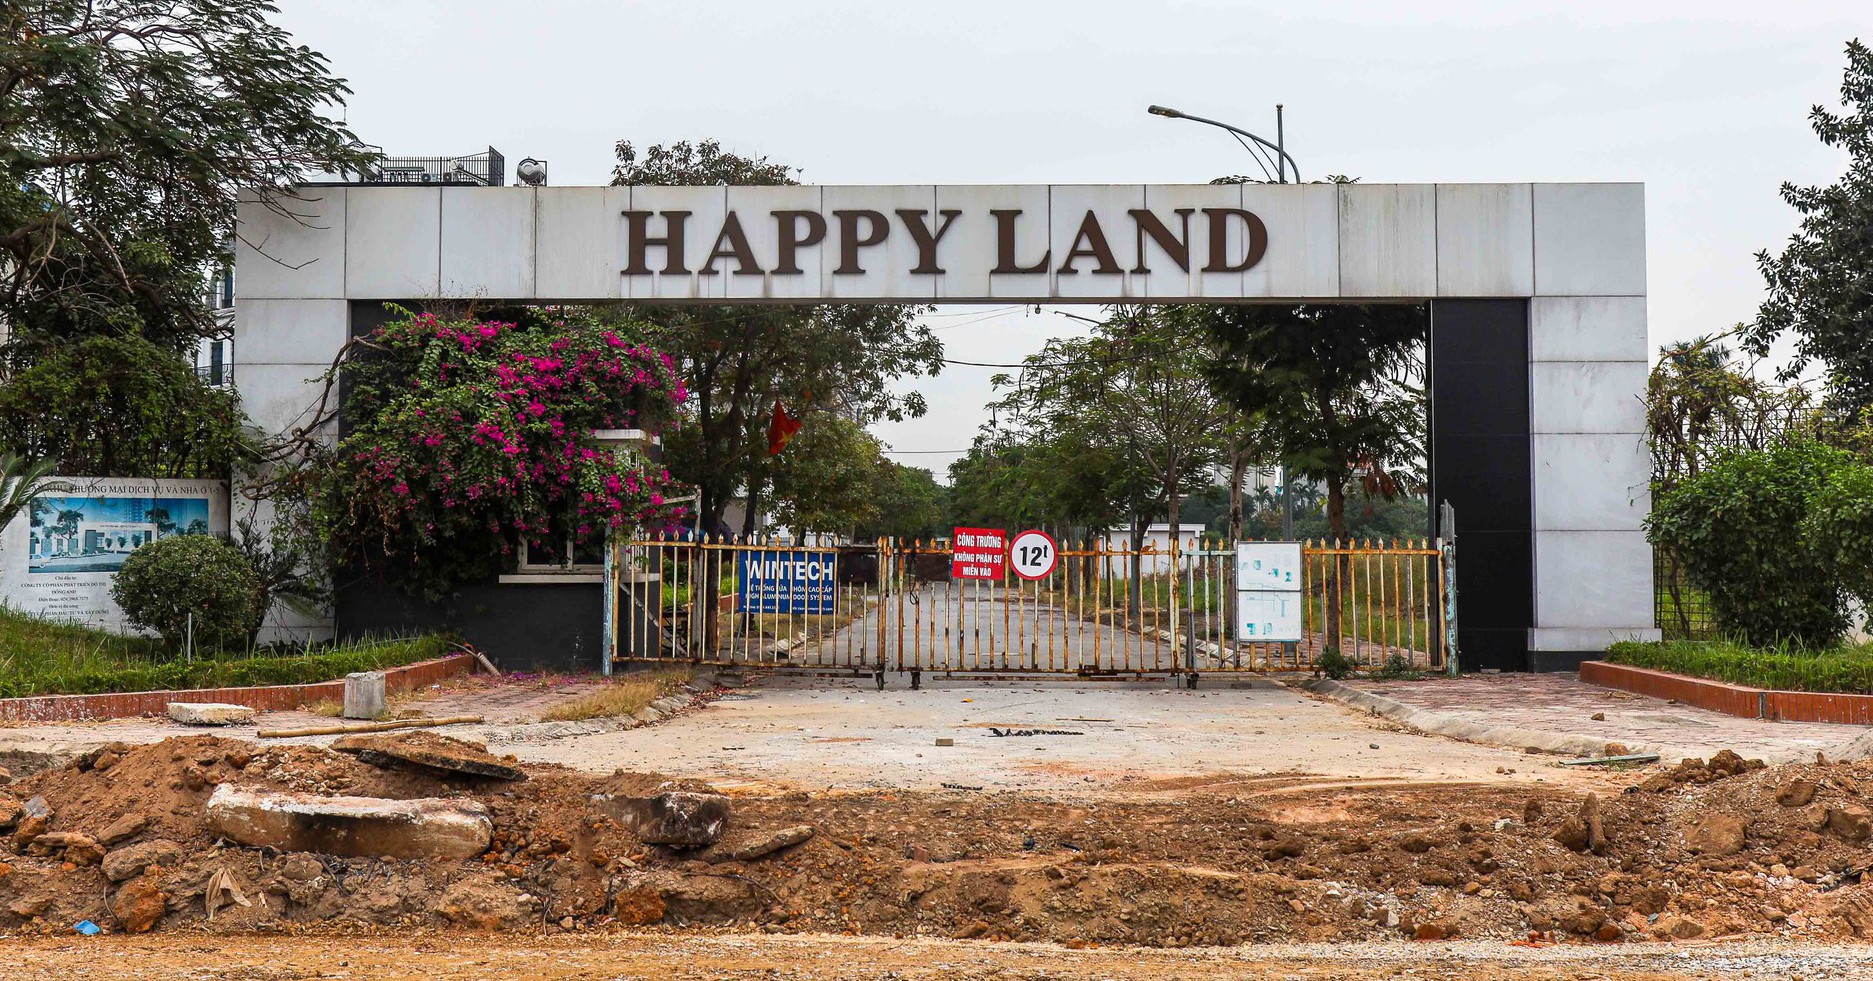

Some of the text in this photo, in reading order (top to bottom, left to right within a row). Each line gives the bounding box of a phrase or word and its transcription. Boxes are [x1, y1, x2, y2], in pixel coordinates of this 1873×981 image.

[619, 207, 1269, 275] HAPPY LAND
[109, 485, 126, 494] MẠI
[128, 485, 149, 494] DỊCH
[180, 484, 198, 494] NHÀ
[957, 532, 1002, 549] CÔNG TRƯỜNG
[954, 551, 975, 563] KHÔNG
[993, 554, 1003, 566] SỰ
[745, 560, 833, 581] WINTECH
[979, 565, 992, 577] VÀO
